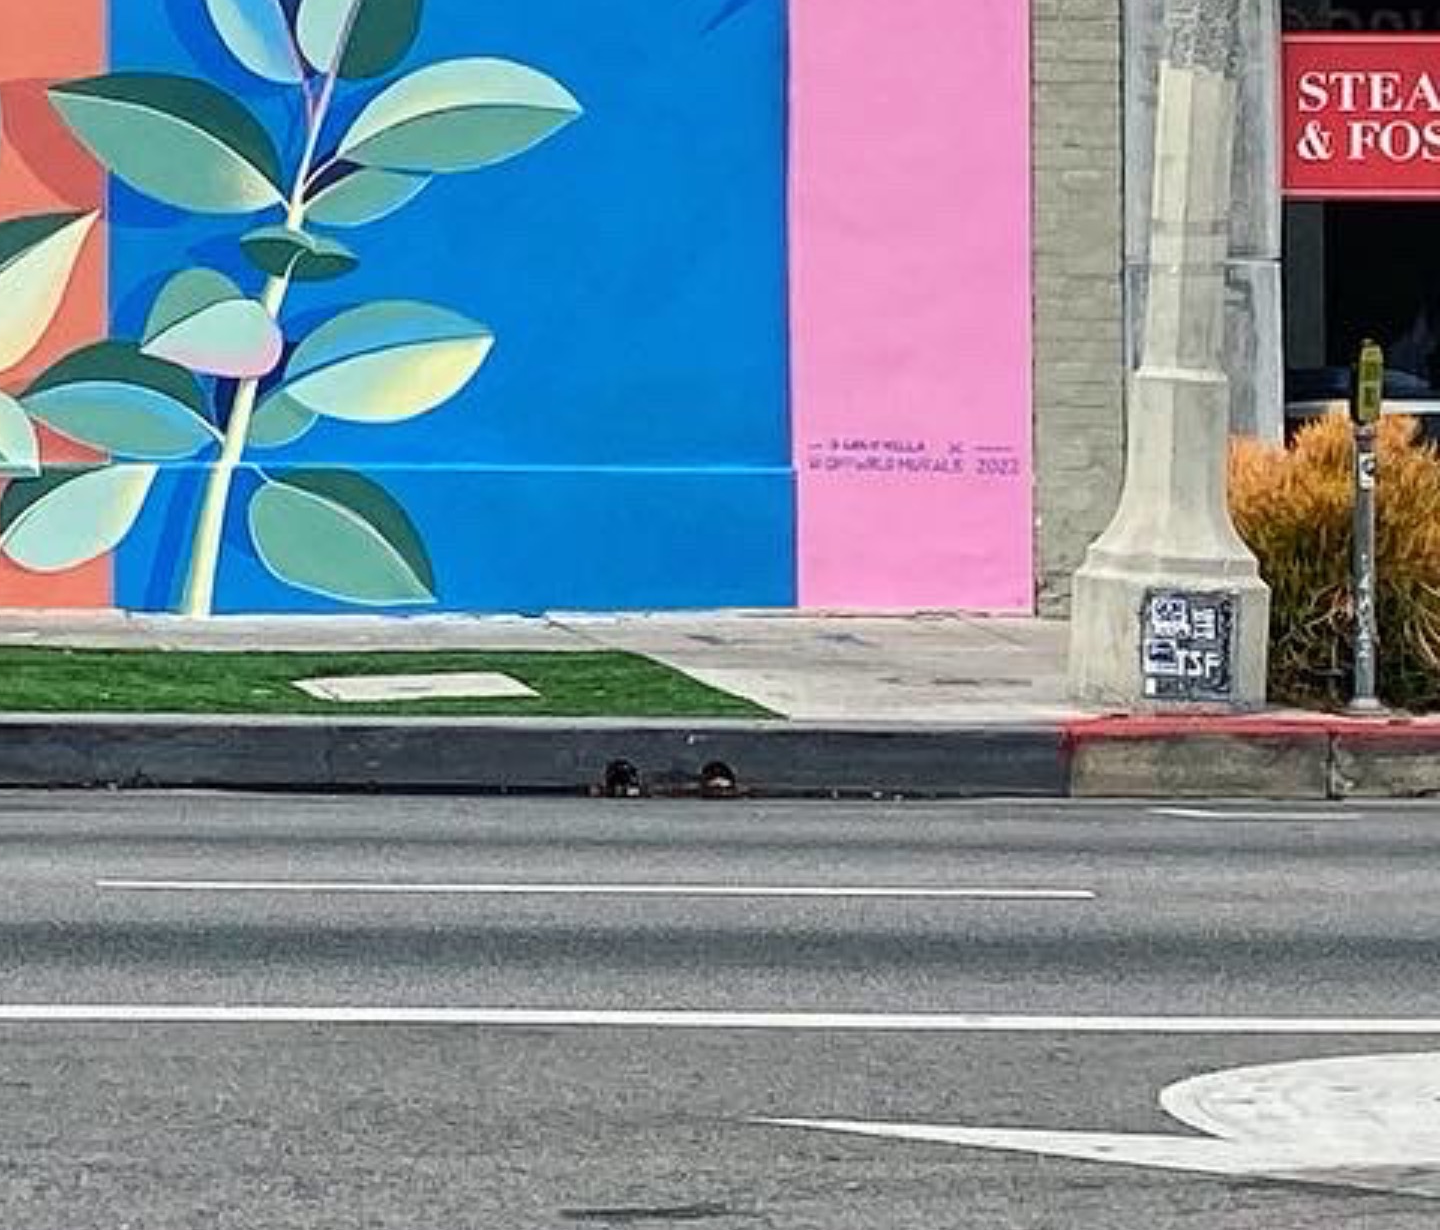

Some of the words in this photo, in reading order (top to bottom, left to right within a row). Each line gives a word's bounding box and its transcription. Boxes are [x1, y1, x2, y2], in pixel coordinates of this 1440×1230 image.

[1297, 70, 1440, 112] STEA
[1296, 119, 1334, 161] &
[1346, 119, 1440, 163] FOS
